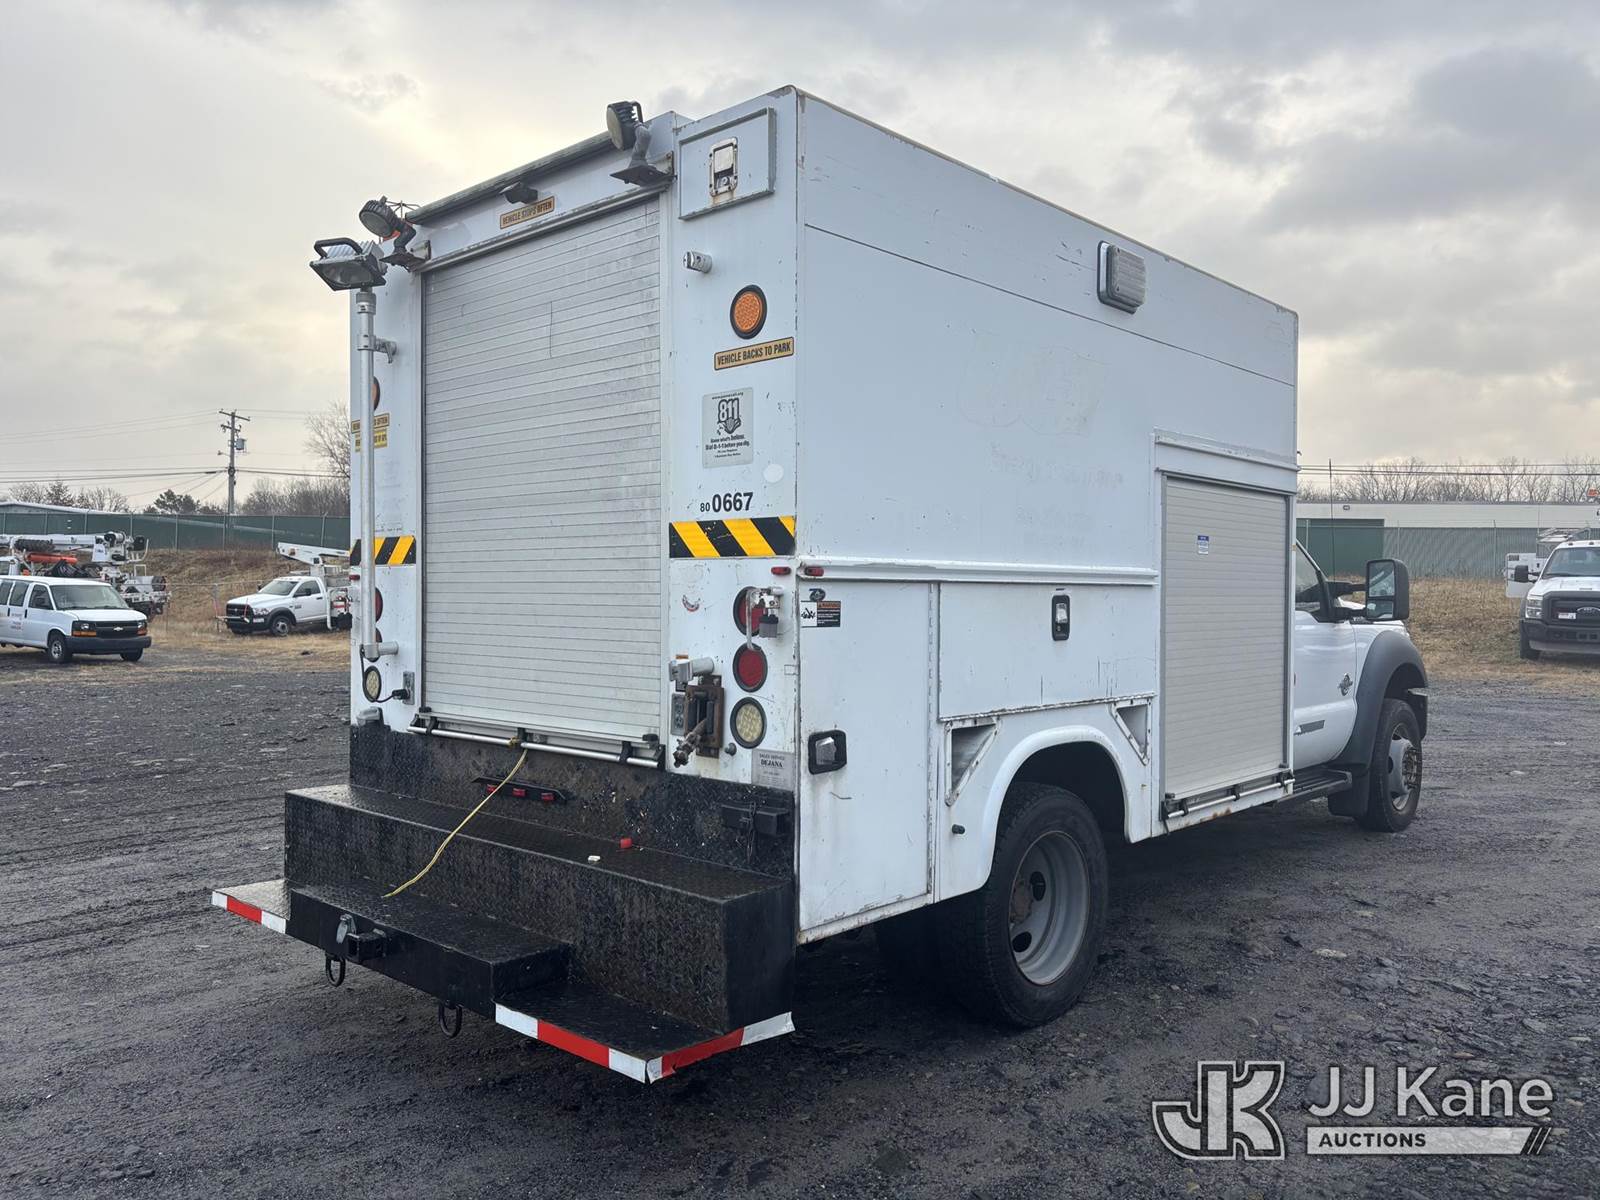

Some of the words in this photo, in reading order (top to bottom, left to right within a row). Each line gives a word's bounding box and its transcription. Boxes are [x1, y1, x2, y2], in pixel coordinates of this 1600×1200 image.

[717, 352, 741, 366] VEHICLE
[742, 347, 764, 360] BACKS
[765, 345, 773, 356] TO
[774, 341, 791, 354] PARK
[718, 397, 740, 423] 811
[700, 502, 710, 512] 80
[712, 491, 754, 513] 0667
[760, 758, 784, 768] DEJANA
